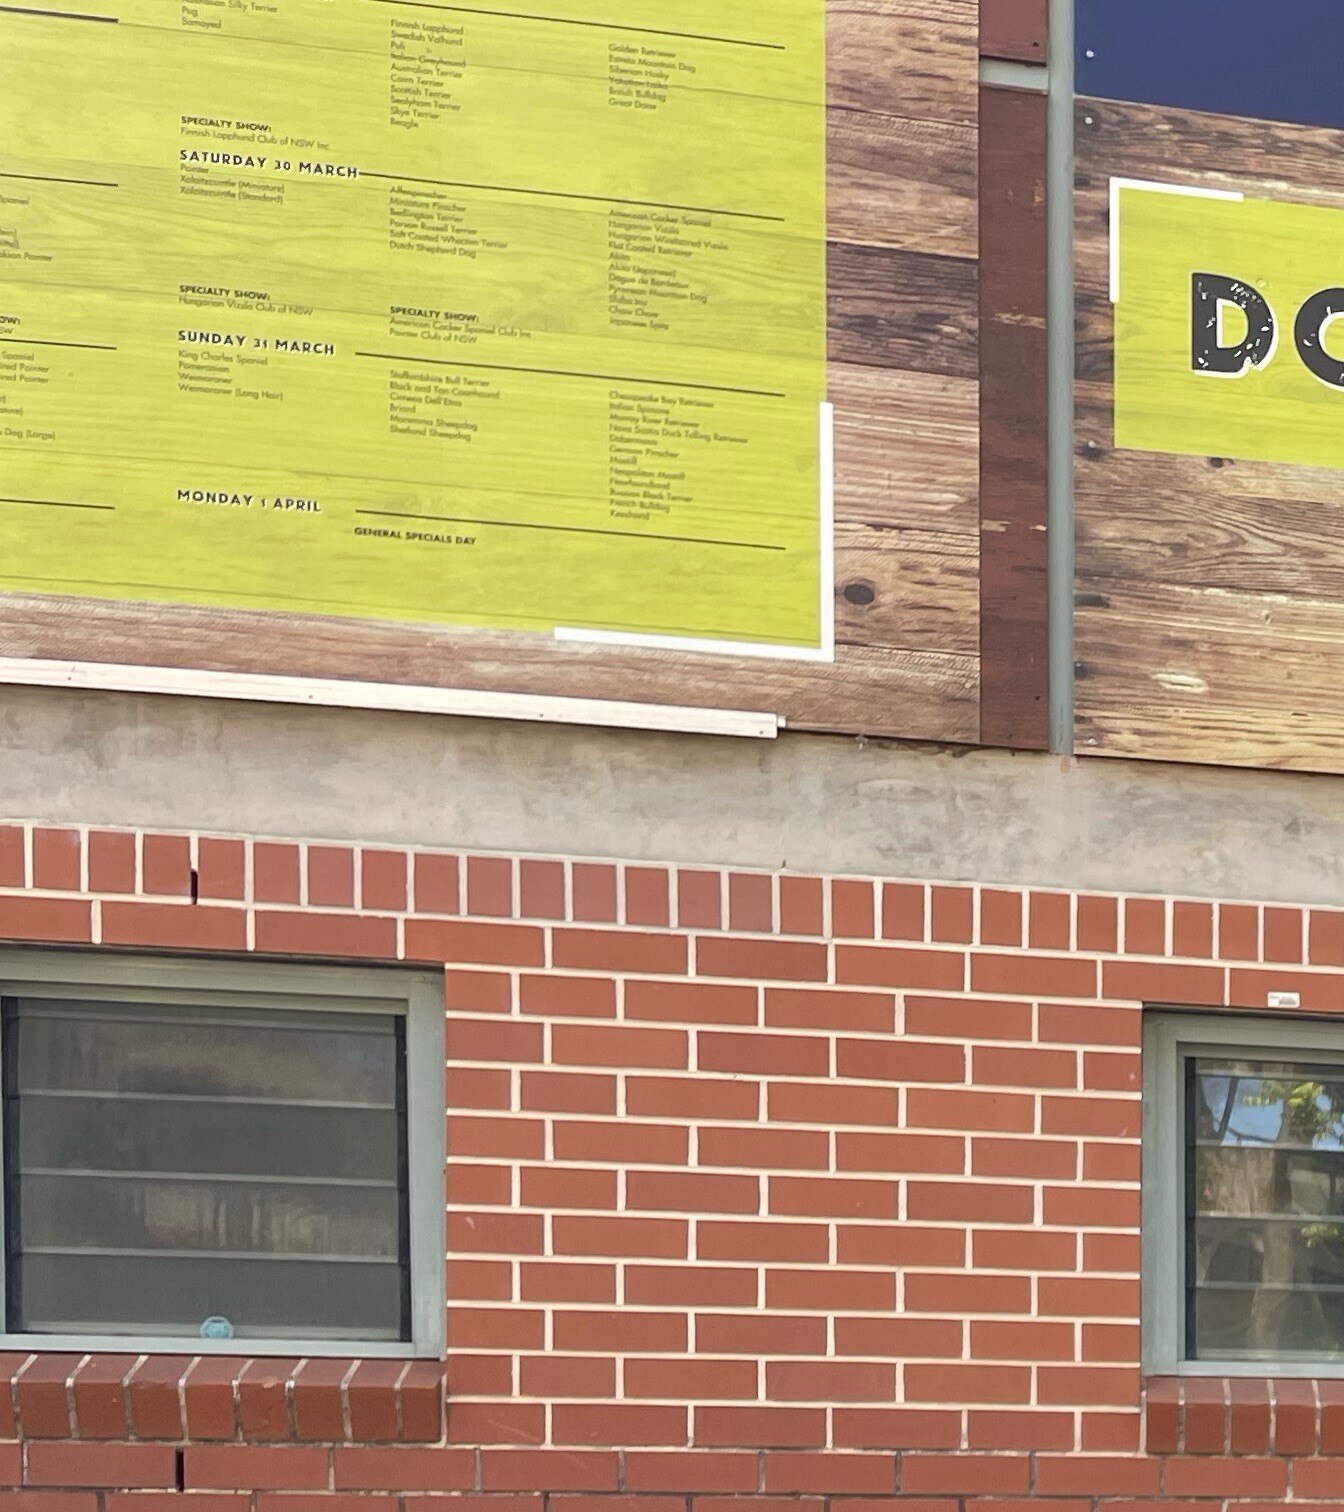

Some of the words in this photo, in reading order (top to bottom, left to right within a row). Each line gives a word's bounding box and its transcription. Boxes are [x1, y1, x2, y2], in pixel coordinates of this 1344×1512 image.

[182, 5, 198, 17] Pug
[182, 17, 221, 30] Samoyed
[678, 62, 696, 74] Dog
[181, 116, 232, 129] SPECIALTY
[236, 121, 271, 133] SHOW:
[180, 127, 211, 138] Finnish
[213, 130, 255, 143] Lapphund
[257, 134, 277, 145] Club
[280, 136, 288, 146] of
[291, 137, 314, 149] NSW
[180, 150, 266, 168] SATURDAY
[275, 160, 291, 171] 30
[299, 162, 358, 178] MARCH
[179, 284, 230, 297] SPECIALTY
[234, 290, 270, 301] SHOW:
[255, 302, 275, 313] Club
[277, 304, 287, 314] of
[289, 304, 313, 316] NSW
[390, 306, 440, 319] SPECIALTY
[178, 330, 247, 347] SUNDAY
[253, 338, 268, 349] 31
[275, 339, 334, 355] MARCH
[420, 330, 441, 340] Club
[454, 333, 478, 344] NSW
[178, 350, 199, 361] King
[201, 352, 233, 363] Charles
[236, 354, 268, 366] Spaniel
[4, 427, 23, 439] Dog
[177, 489, 254, 507] MONDAY
[261, 498, 267, 509] 1
[273, 497, 322, 513] APRIL
[354, 527, 401, 540] GENERAL
[406, 531, 452, 544] SPECIALS
[456, 536, 477, 546] DAY
